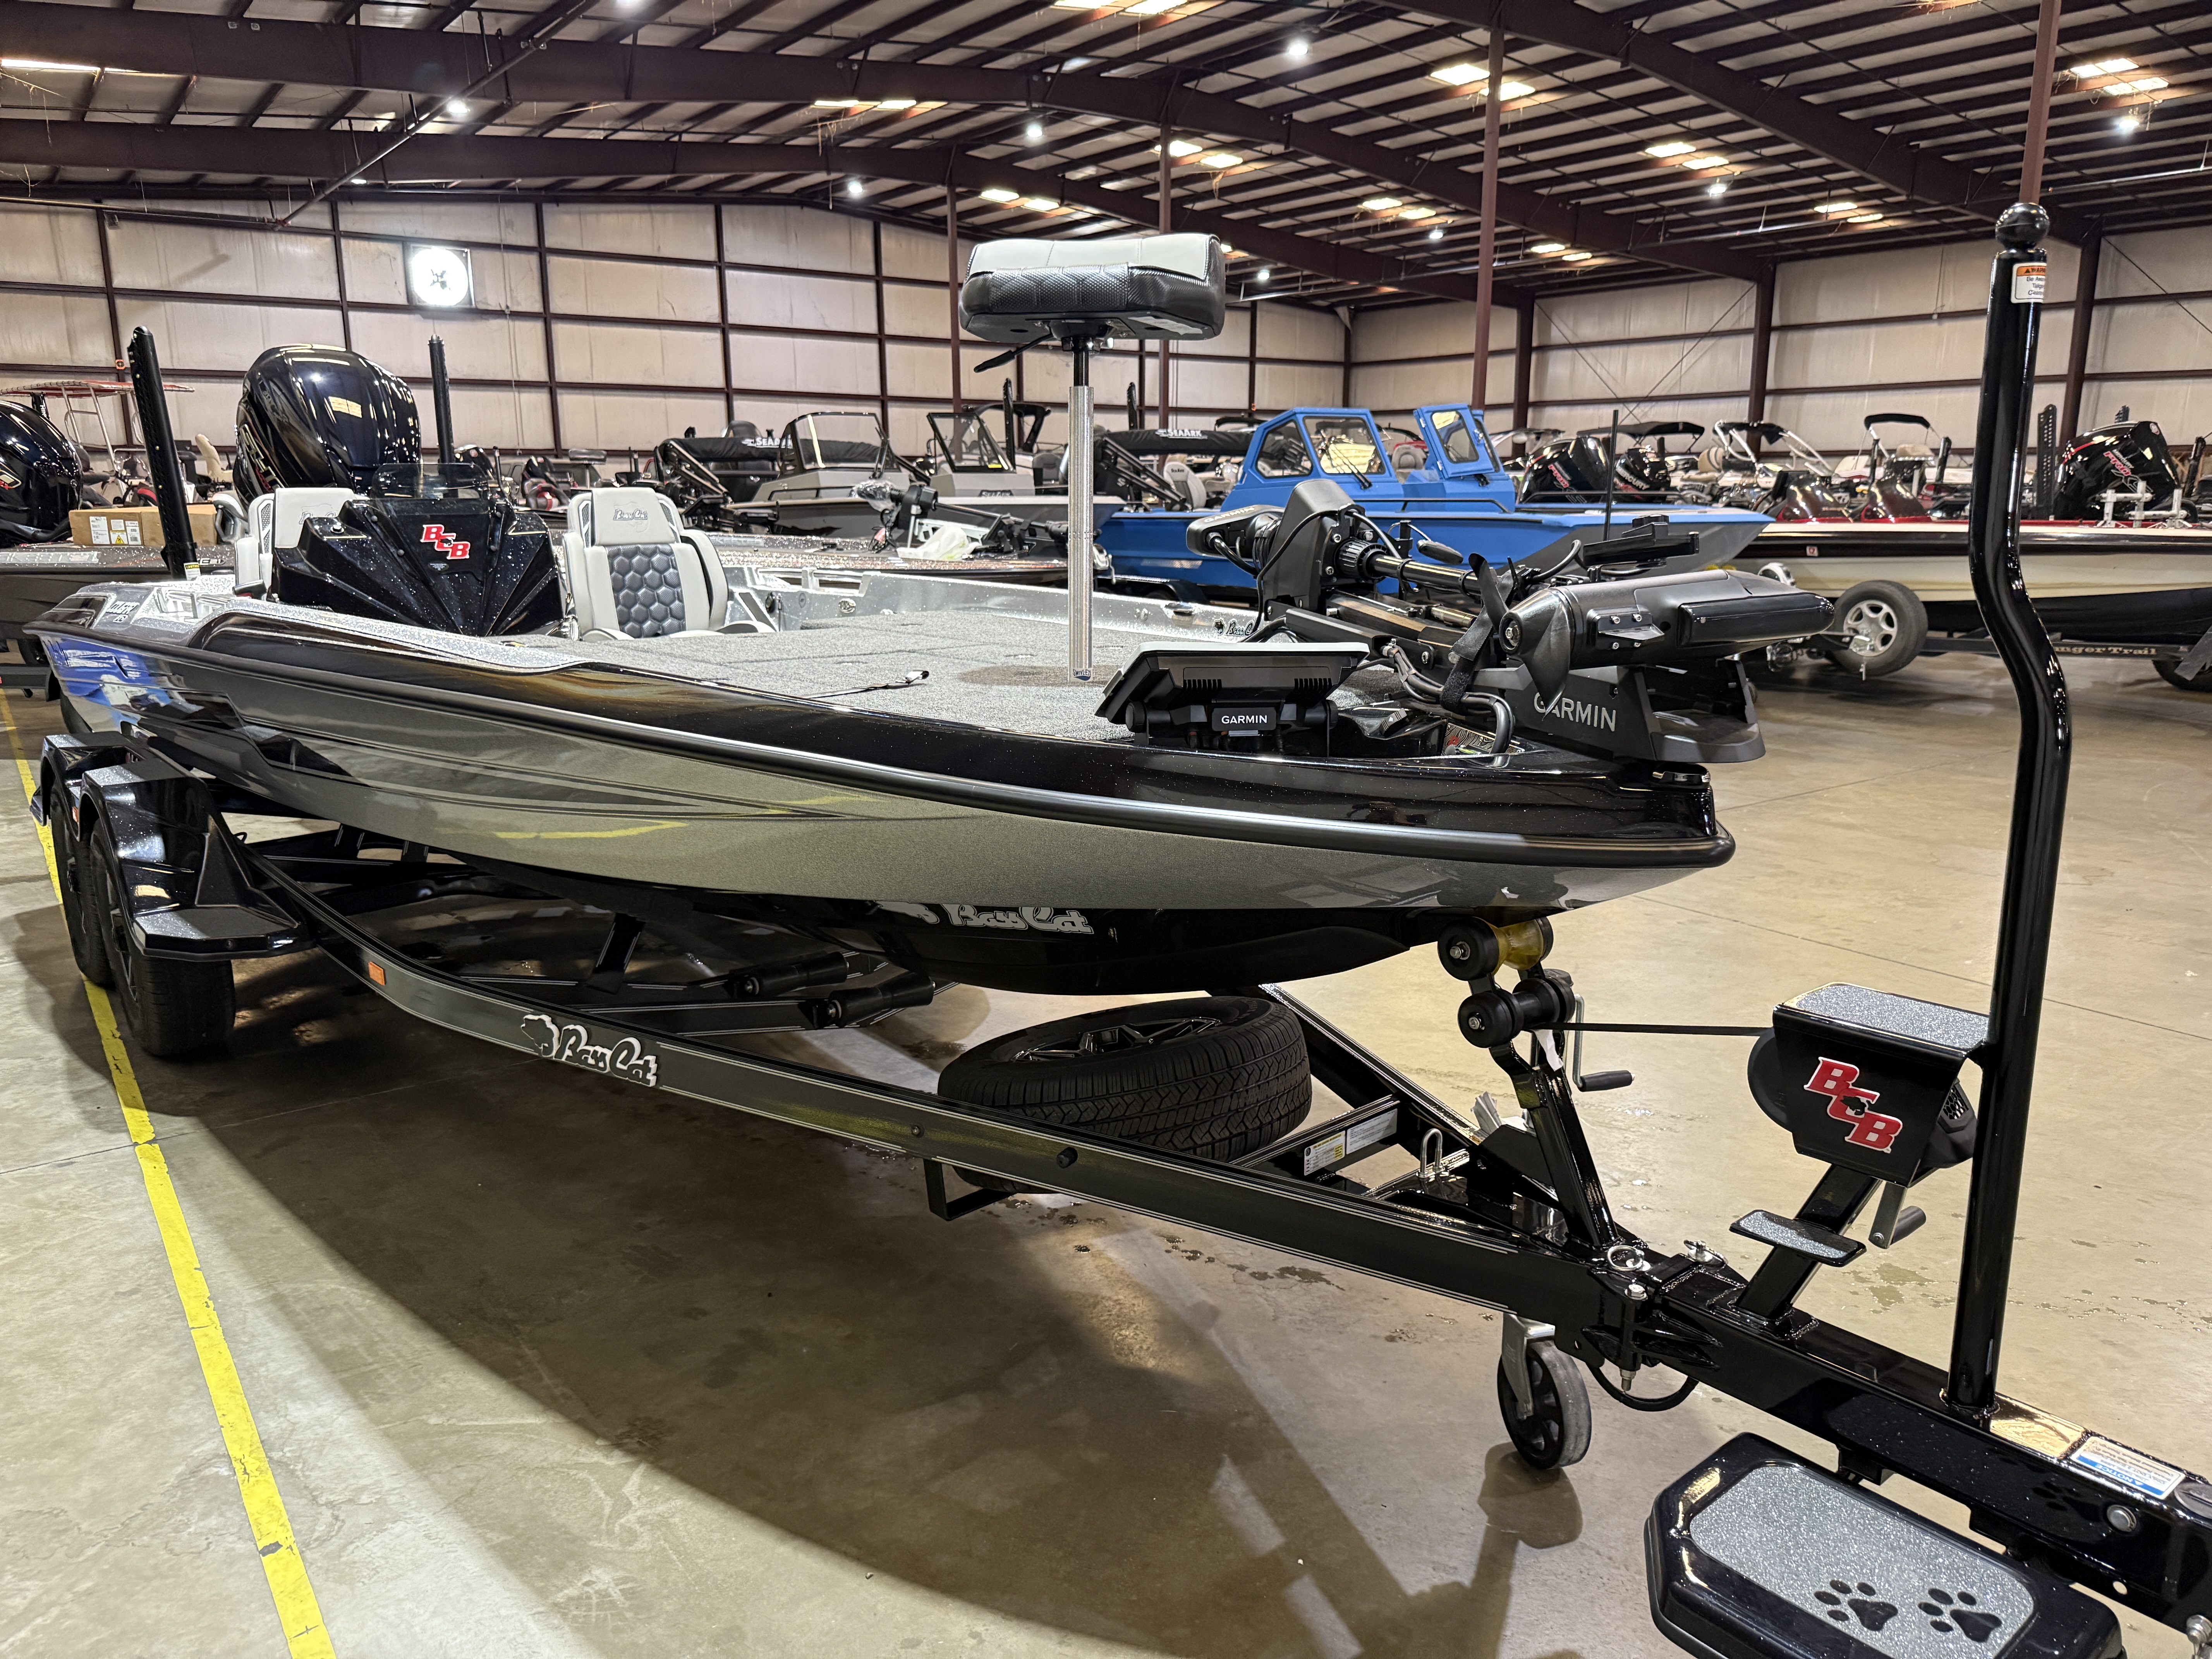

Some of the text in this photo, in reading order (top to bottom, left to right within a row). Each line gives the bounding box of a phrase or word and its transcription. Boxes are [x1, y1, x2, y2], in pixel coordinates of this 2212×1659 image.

[1221, 715, 1267, 724] GARMIN
[941, 904, 1094, 934] Bass Cat
[553, 1025, 658, 1087] Bass Cat
[1803, 1056, 1903, 1150] BCB
[2095, 1463, 2134, 1482] NOTICE
